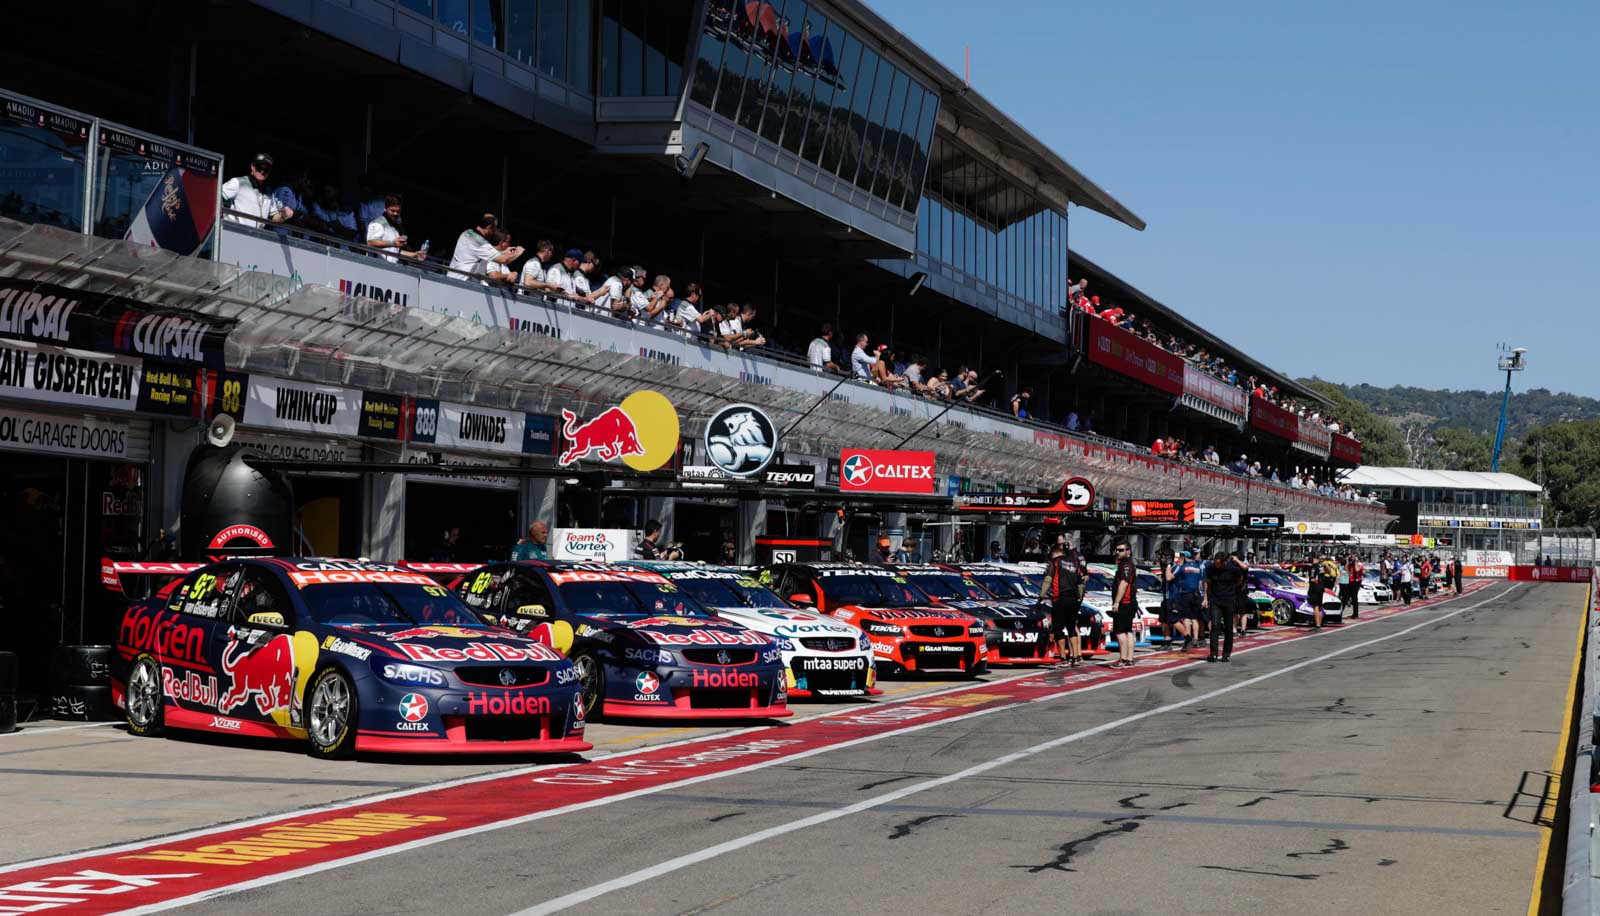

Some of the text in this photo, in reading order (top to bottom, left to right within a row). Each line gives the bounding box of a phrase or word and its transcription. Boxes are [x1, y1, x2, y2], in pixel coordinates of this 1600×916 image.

[6, 101, 35, 117] AMADIO
[50, 115, 77, 130] AMADIO
[110, 132, 136, 147] AMADIO
[0, 288, 78, 341] LIPSAL
[133, 314, 210, 362] CLIPSAL
[33, 352, 134, 400] GISBERGEN
[222, 379, 241, 413] 88
[276, 387, 337, 425] WHINCUP
[415, 406, 436, 436] 888
[459, 411, 506, 444] LOWNDES
[22, 420, 77, 448] GARAGE
[80, 428, 125, 454] DOORS
[765, 471, 814, 482] TEKNO
[875, 464, 932, 479] CALTEX
[1147, 501, 1173, 509] Wilson
[1147, 509, 1179, 518] Security
[1200, 512, 1232, 522] pra
[1250, 516, 1279, 525] pra
[216, 527, 268, 545] AUTHORISED
[567, 533, 595, 542] Team
[568, 542, 608, 551] Vortex
[775, 552, 794, 564] SD
[291, 572, 439, 586] Holden
[551, 572, 673, 584] Holden
[818, 569, 896, 577] TEKNO
[422, 585, 447, 597] 97
[252, 615, 283, 625] IVECO
[119, 605, 205, 661] Holden
[783, 624, 853, 634] Vortex
[870, 625, 901, 633] TEKNO
[625, 647, 672, 663] SACHS
[803, 657, 857, 671] mtaa super
[384, 664, 443, 685] SACHS
[693, 668, 759, 687] Holden
[468, 691, 550, 715] Holden
[634, 693, 661, 701] CALTEX
[396, 722, 429, 731] CALTEX
